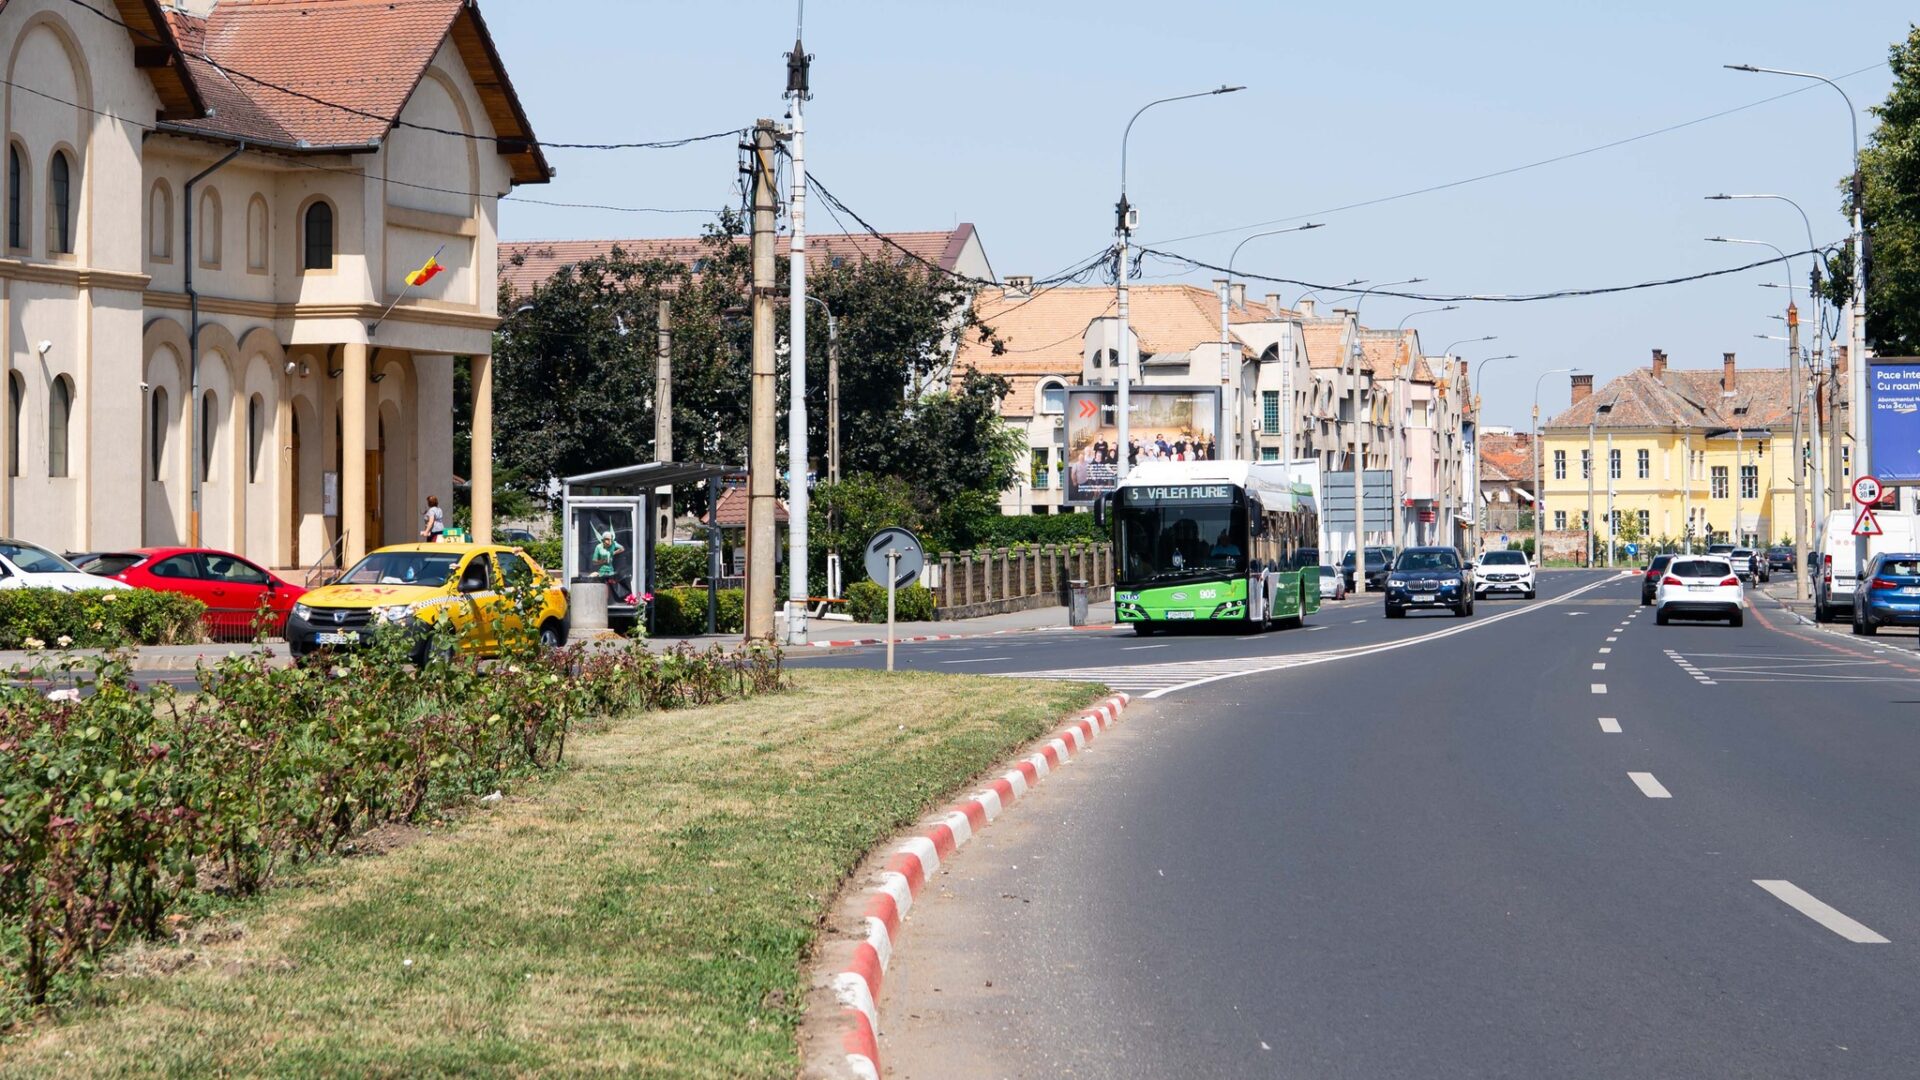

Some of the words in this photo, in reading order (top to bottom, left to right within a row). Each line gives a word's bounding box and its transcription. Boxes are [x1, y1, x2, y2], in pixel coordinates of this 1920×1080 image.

[1877, 371, 1901, 380] Pace
[1878, 382, 1890, 391] Cu
[1132, 488, 1139, 500] 5
[1147, 487, 1188, 499] VALEA
[1191, 486, 1228, 498] AURIE
[1199, 589, 1216, 599] 905
